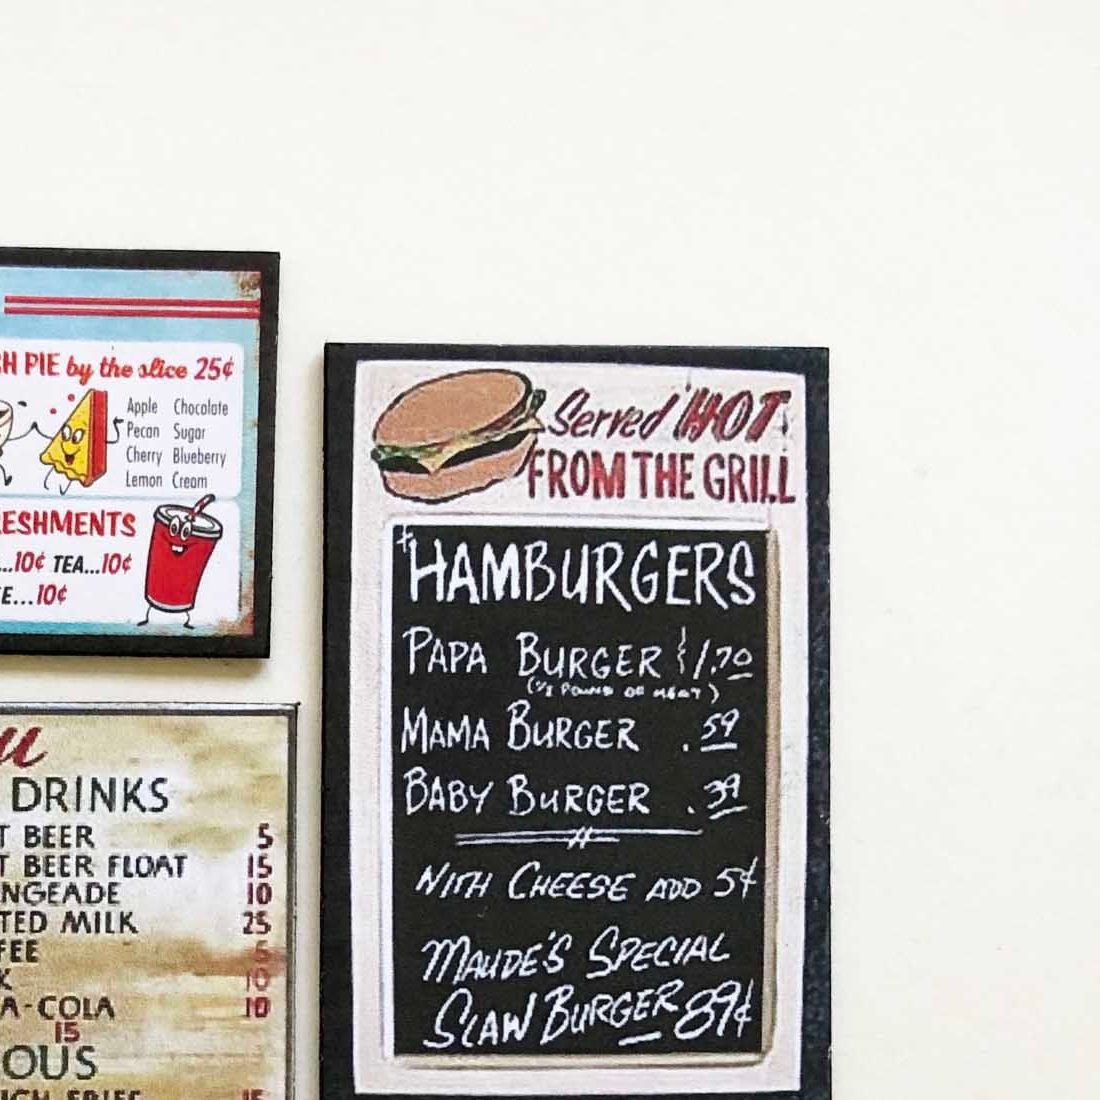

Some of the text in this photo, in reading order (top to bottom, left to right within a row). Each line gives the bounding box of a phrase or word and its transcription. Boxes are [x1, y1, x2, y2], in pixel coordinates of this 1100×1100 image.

[25, 352, 60, 375] PIE
[66, 358, 93, 385] by
[100, 357, 133, 379] the
[138, 358, 188, 380] slice
[126, 398, 158, 417] Apple
[174, 399, 228, 417] Chocolate
[548, 386, 791, 442] Served HOT
[126, 423, 160, 439] Pecan
[173, 423, 205, 442] Sugar
[126, 447, 162, 467] Cherry
[173, 447, 226, 467] Blueberry
[125, 472, 162, 488] Lemon
[172, 473, 207, 489] Cream
[529, 449, 795, 504] FROM THE GRILL
[410, 538, 756, 612] HAMBURGERS
[12, 775, 169, 814] DRINKS
[24, 826, 94, 849] BEER
[23, 855, 94, 878] BEER
[108, 855, 188, 878] FLOAT
[247, 855, 272, 877] 15
[246, 883, 271, 905] 10
[61, 912, 138, 934] MILK
[242, 911, 271, 935] 25
